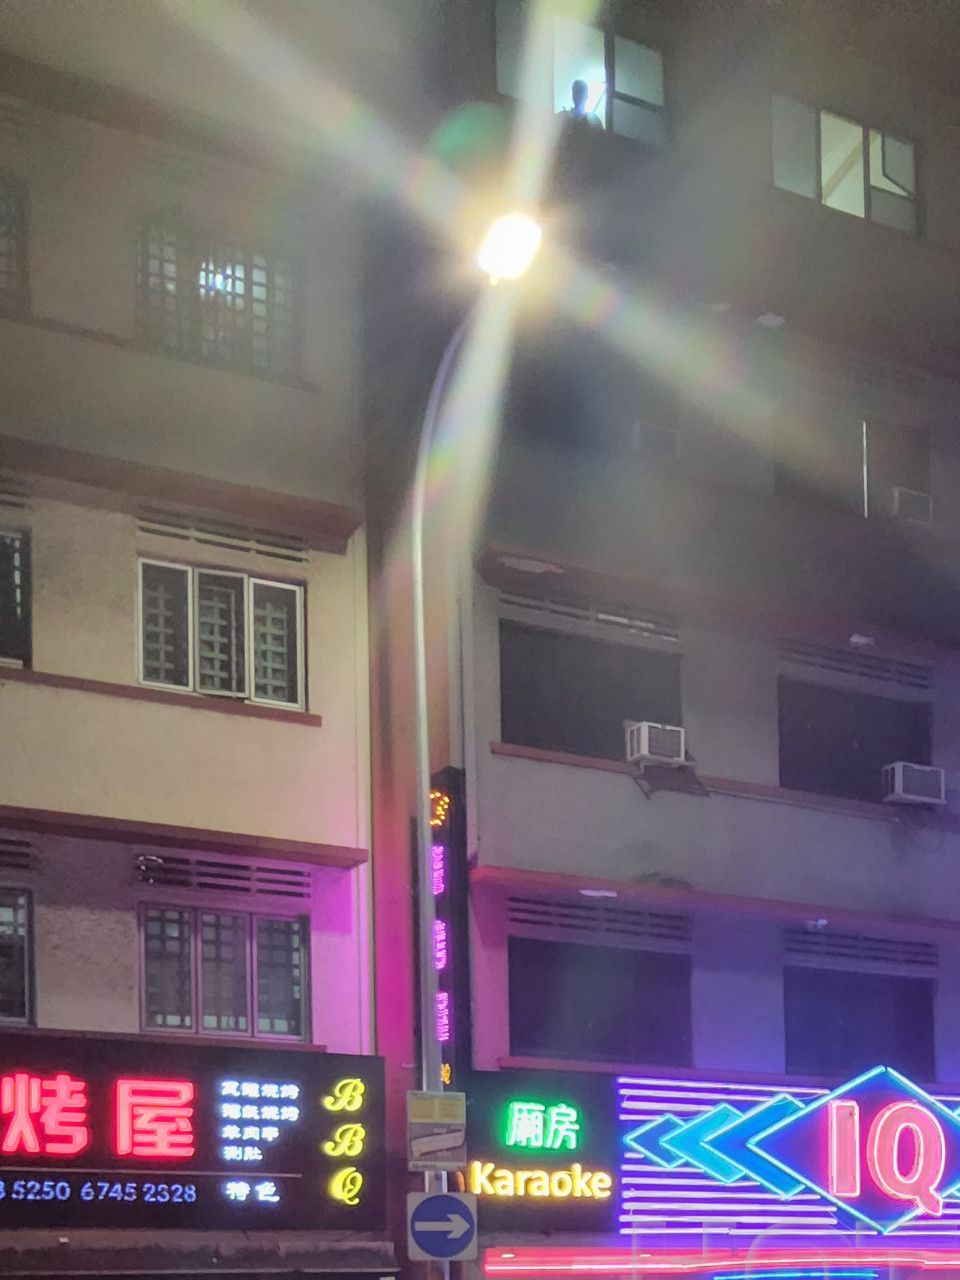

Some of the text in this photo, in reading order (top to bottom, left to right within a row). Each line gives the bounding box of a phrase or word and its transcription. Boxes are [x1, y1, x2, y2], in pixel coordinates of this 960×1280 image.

[1, 1072, 197, 1157] 烤屋
[468, 1160, 612, 1199] Karaoke
[828, 1100, 946, 1217] IQ
[11, 1180, 72, 1201] 5250
[79, 1181, 138, 1202] 6745
[142, 1183, 197, 1203] 2328
